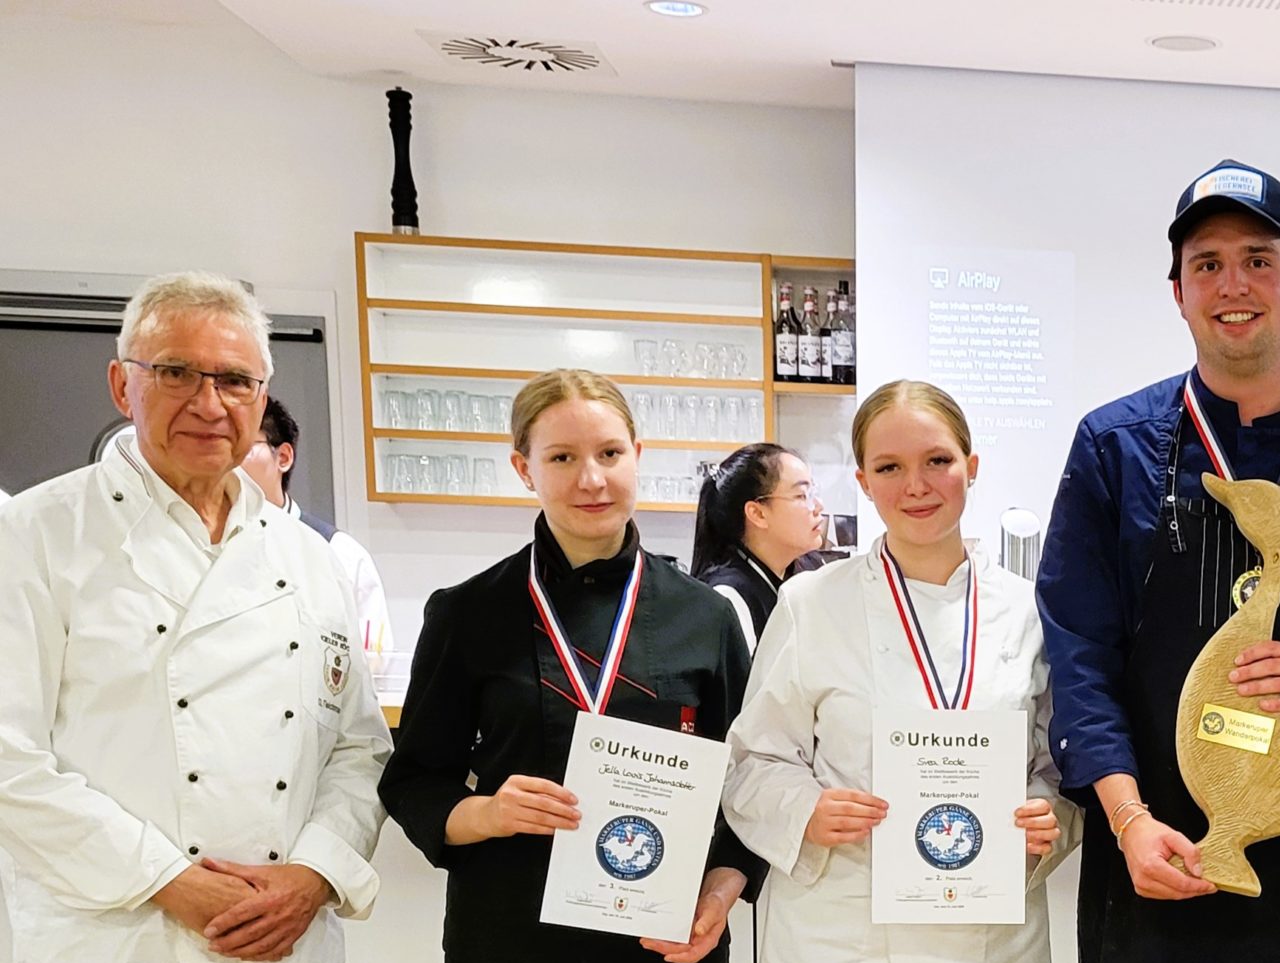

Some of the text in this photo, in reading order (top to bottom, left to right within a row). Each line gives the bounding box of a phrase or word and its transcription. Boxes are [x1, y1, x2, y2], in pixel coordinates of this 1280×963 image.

[957, 271, 1000, 292] AirPlay
[908, 732, 990, 748] Urkunde
[607, 740, 690, 770] Urkunde
[917, 757, 939, 767] Svea
